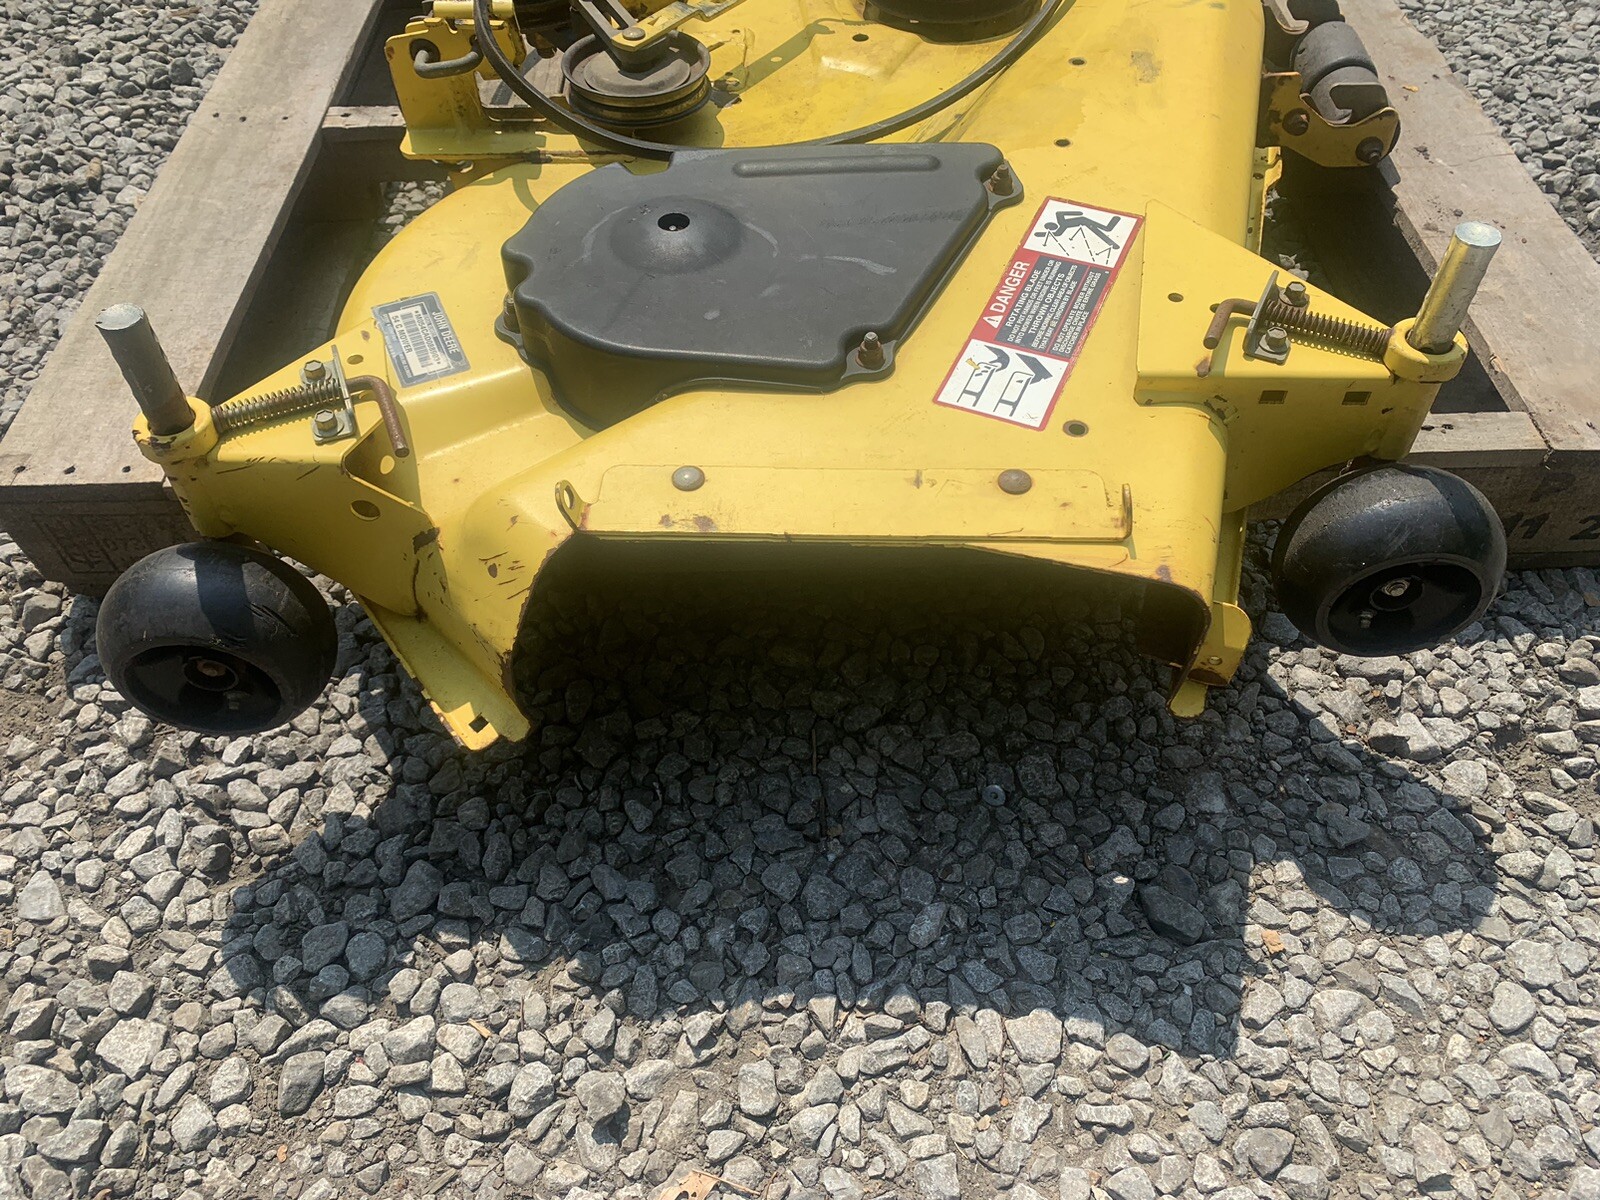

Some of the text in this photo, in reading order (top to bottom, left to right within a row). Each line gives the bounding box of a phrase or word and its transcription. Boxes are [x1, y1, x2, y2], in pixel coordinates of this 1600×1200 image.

[989, 260, 1030, 313] DANGER
[1005, 270, 1042, 327] ROTATING BLADE
[1011, 324, 1021, 334] NOT
[1017, 315, 1026, 324] PUT
[1022, 299, 1034, 315] HANDS
[1033, 281, 1043, 292] FEET
[1028, 273, 1065, 334] THROWN OBJECTS
[1062, 310, 1077, 332] OPERATE
[1073, 292, 1086, 310] MOWER
[1082, 271, 1096, 292] WITHOUT
[397, 329, 413, 354] MOWER
[432, 310, 460, 354] JOHN DEERE
[1014, 332, 1025, 344] INTO
[1020, 314, 1034, 332] MOWER
[1030, 301, 1041, 315] WHEN
[1078, 311, 1090, 326] PLACE
